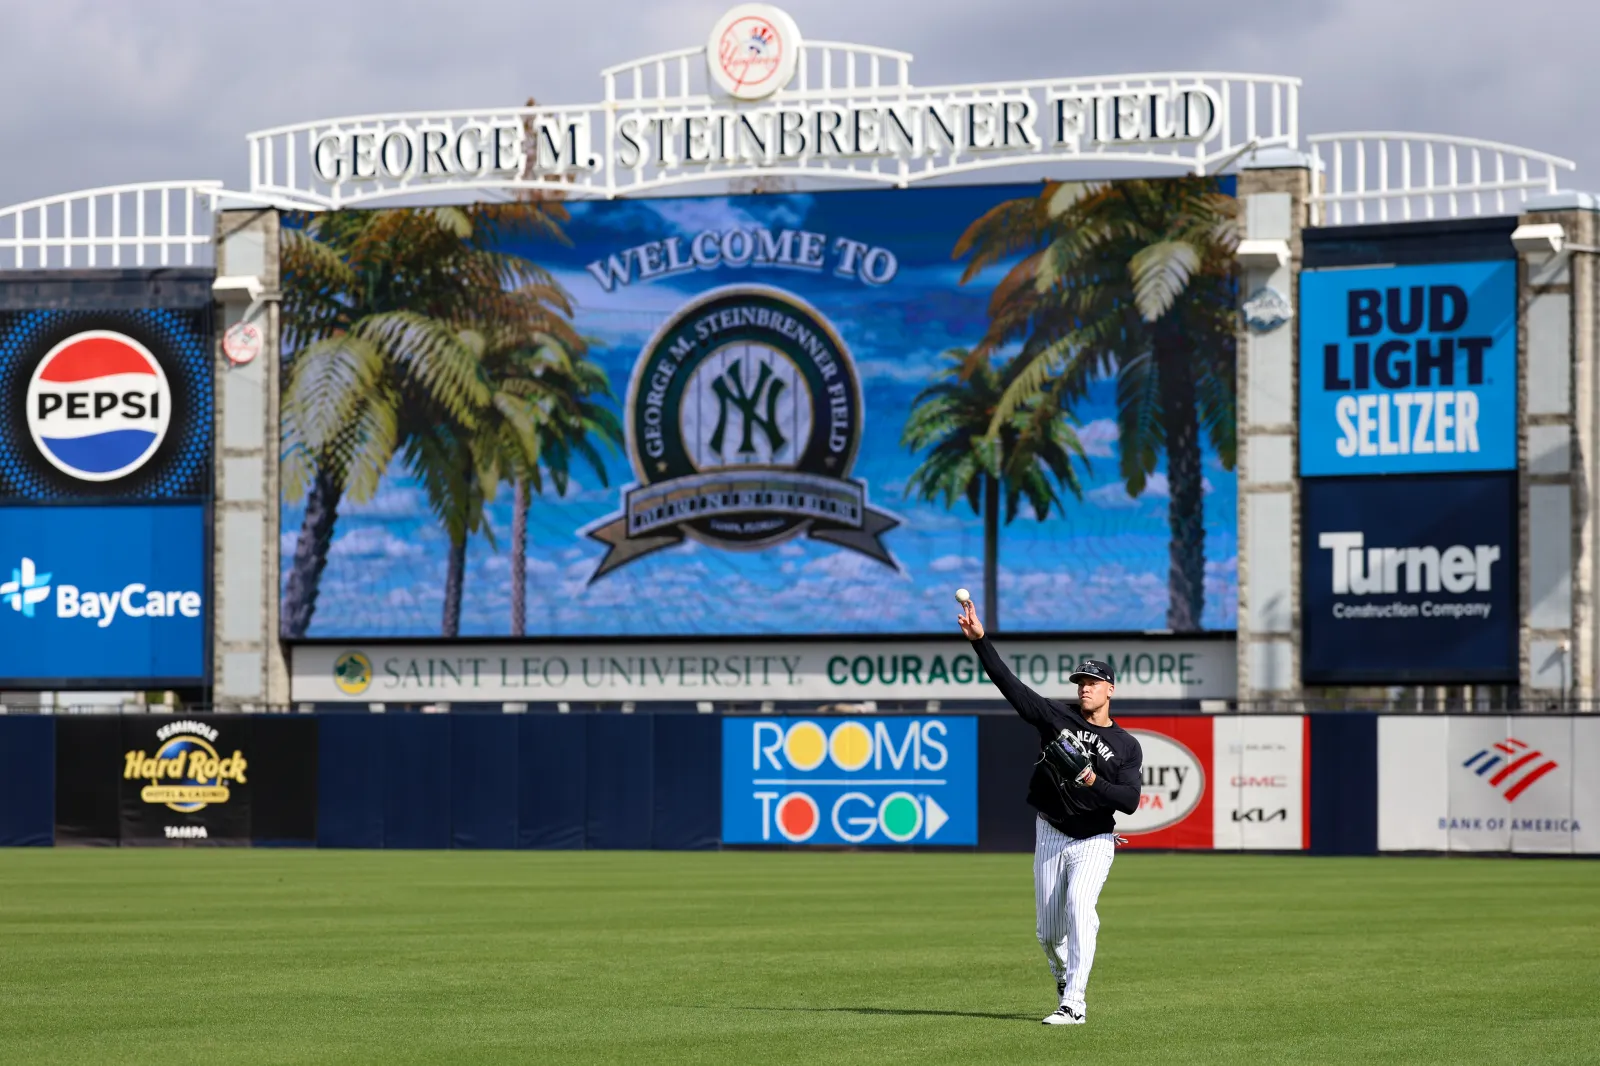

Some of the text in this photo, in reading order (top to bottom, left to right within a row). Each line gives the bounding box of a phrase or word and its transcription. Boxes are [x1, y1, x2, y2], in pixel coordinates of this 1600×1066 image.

[314, 91, 1216, 180] GEORGE M. STEINBRENNER FIELD
[586, 228, 898, 292] WELCOME TO
[1347, 284, 1468, 337] BUD
[644, 307, 848, 458] GEORGE M. STEINBRENNER FIELD
[1323, 336, 1493, 391] LIGHT
[38, 391, 159, 419] PEPSI
[1335, 391, 1480, 457] SELTZER
[1318, 532, 1500, 595] Turner
[56, 583, 201, 628] BayCare
[1332, 601, 1491, 619] Construction Company
[384, 657, 488, 688] SAINT
[499, 656, 569, 687] LEO
[1010, 654, 1048, 685] TO
[1107, 653, 1203, 684] MORE.
[156, 720, 219, 742] SEMINOLE
[753, 720, 949, 772] ROOMS
[1076, 730, 1098, 744] NEW
[123, 750, 248, 783] Hard Rock
[164, 826, 207, 838] TAMPA
[753, 791, 923, 842] TO GO
[1438, 817, 1581, 832] BANK OF AMERICA
